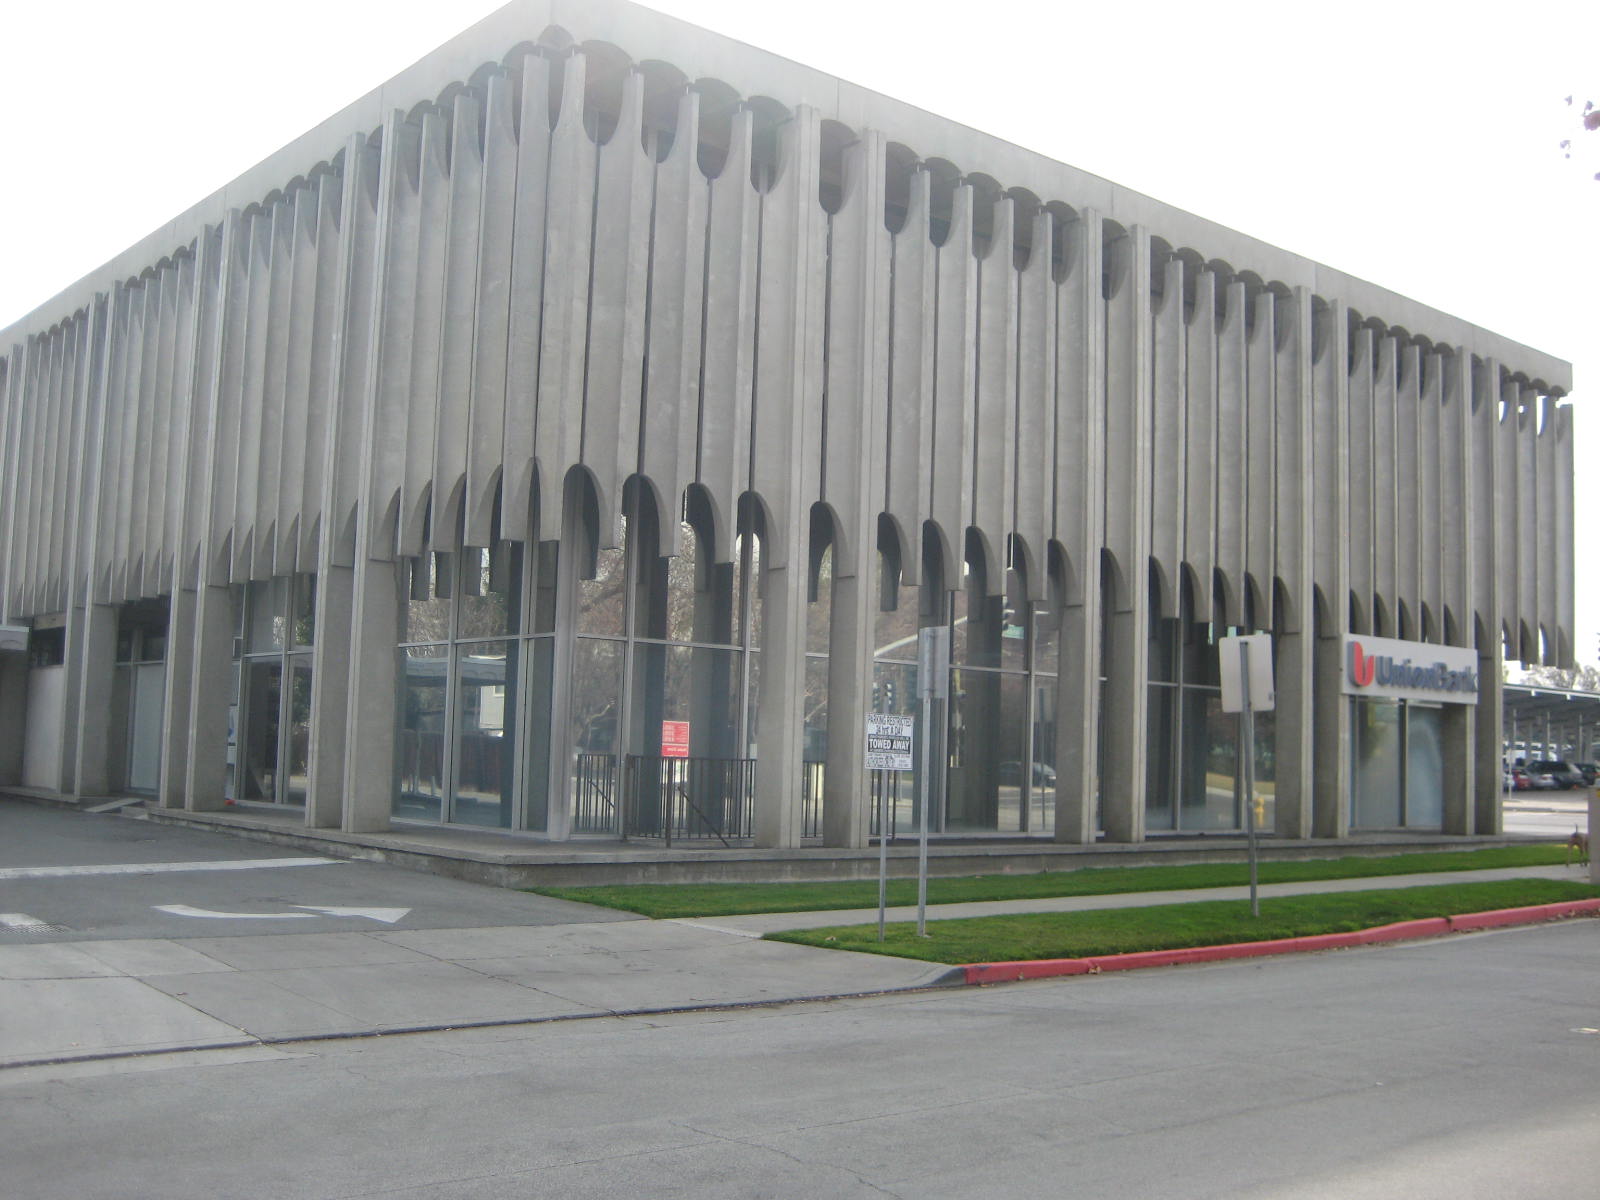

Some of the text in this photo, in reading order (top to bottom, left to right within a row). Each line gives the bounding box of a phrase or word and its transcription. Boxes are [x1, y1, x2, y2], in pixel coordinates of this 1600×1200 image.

[1376, 655, 1478, 693] UnionBank
[868, 714, 886, 725] PARKING
[869, 739, 910, 750] TOWED AWAY
